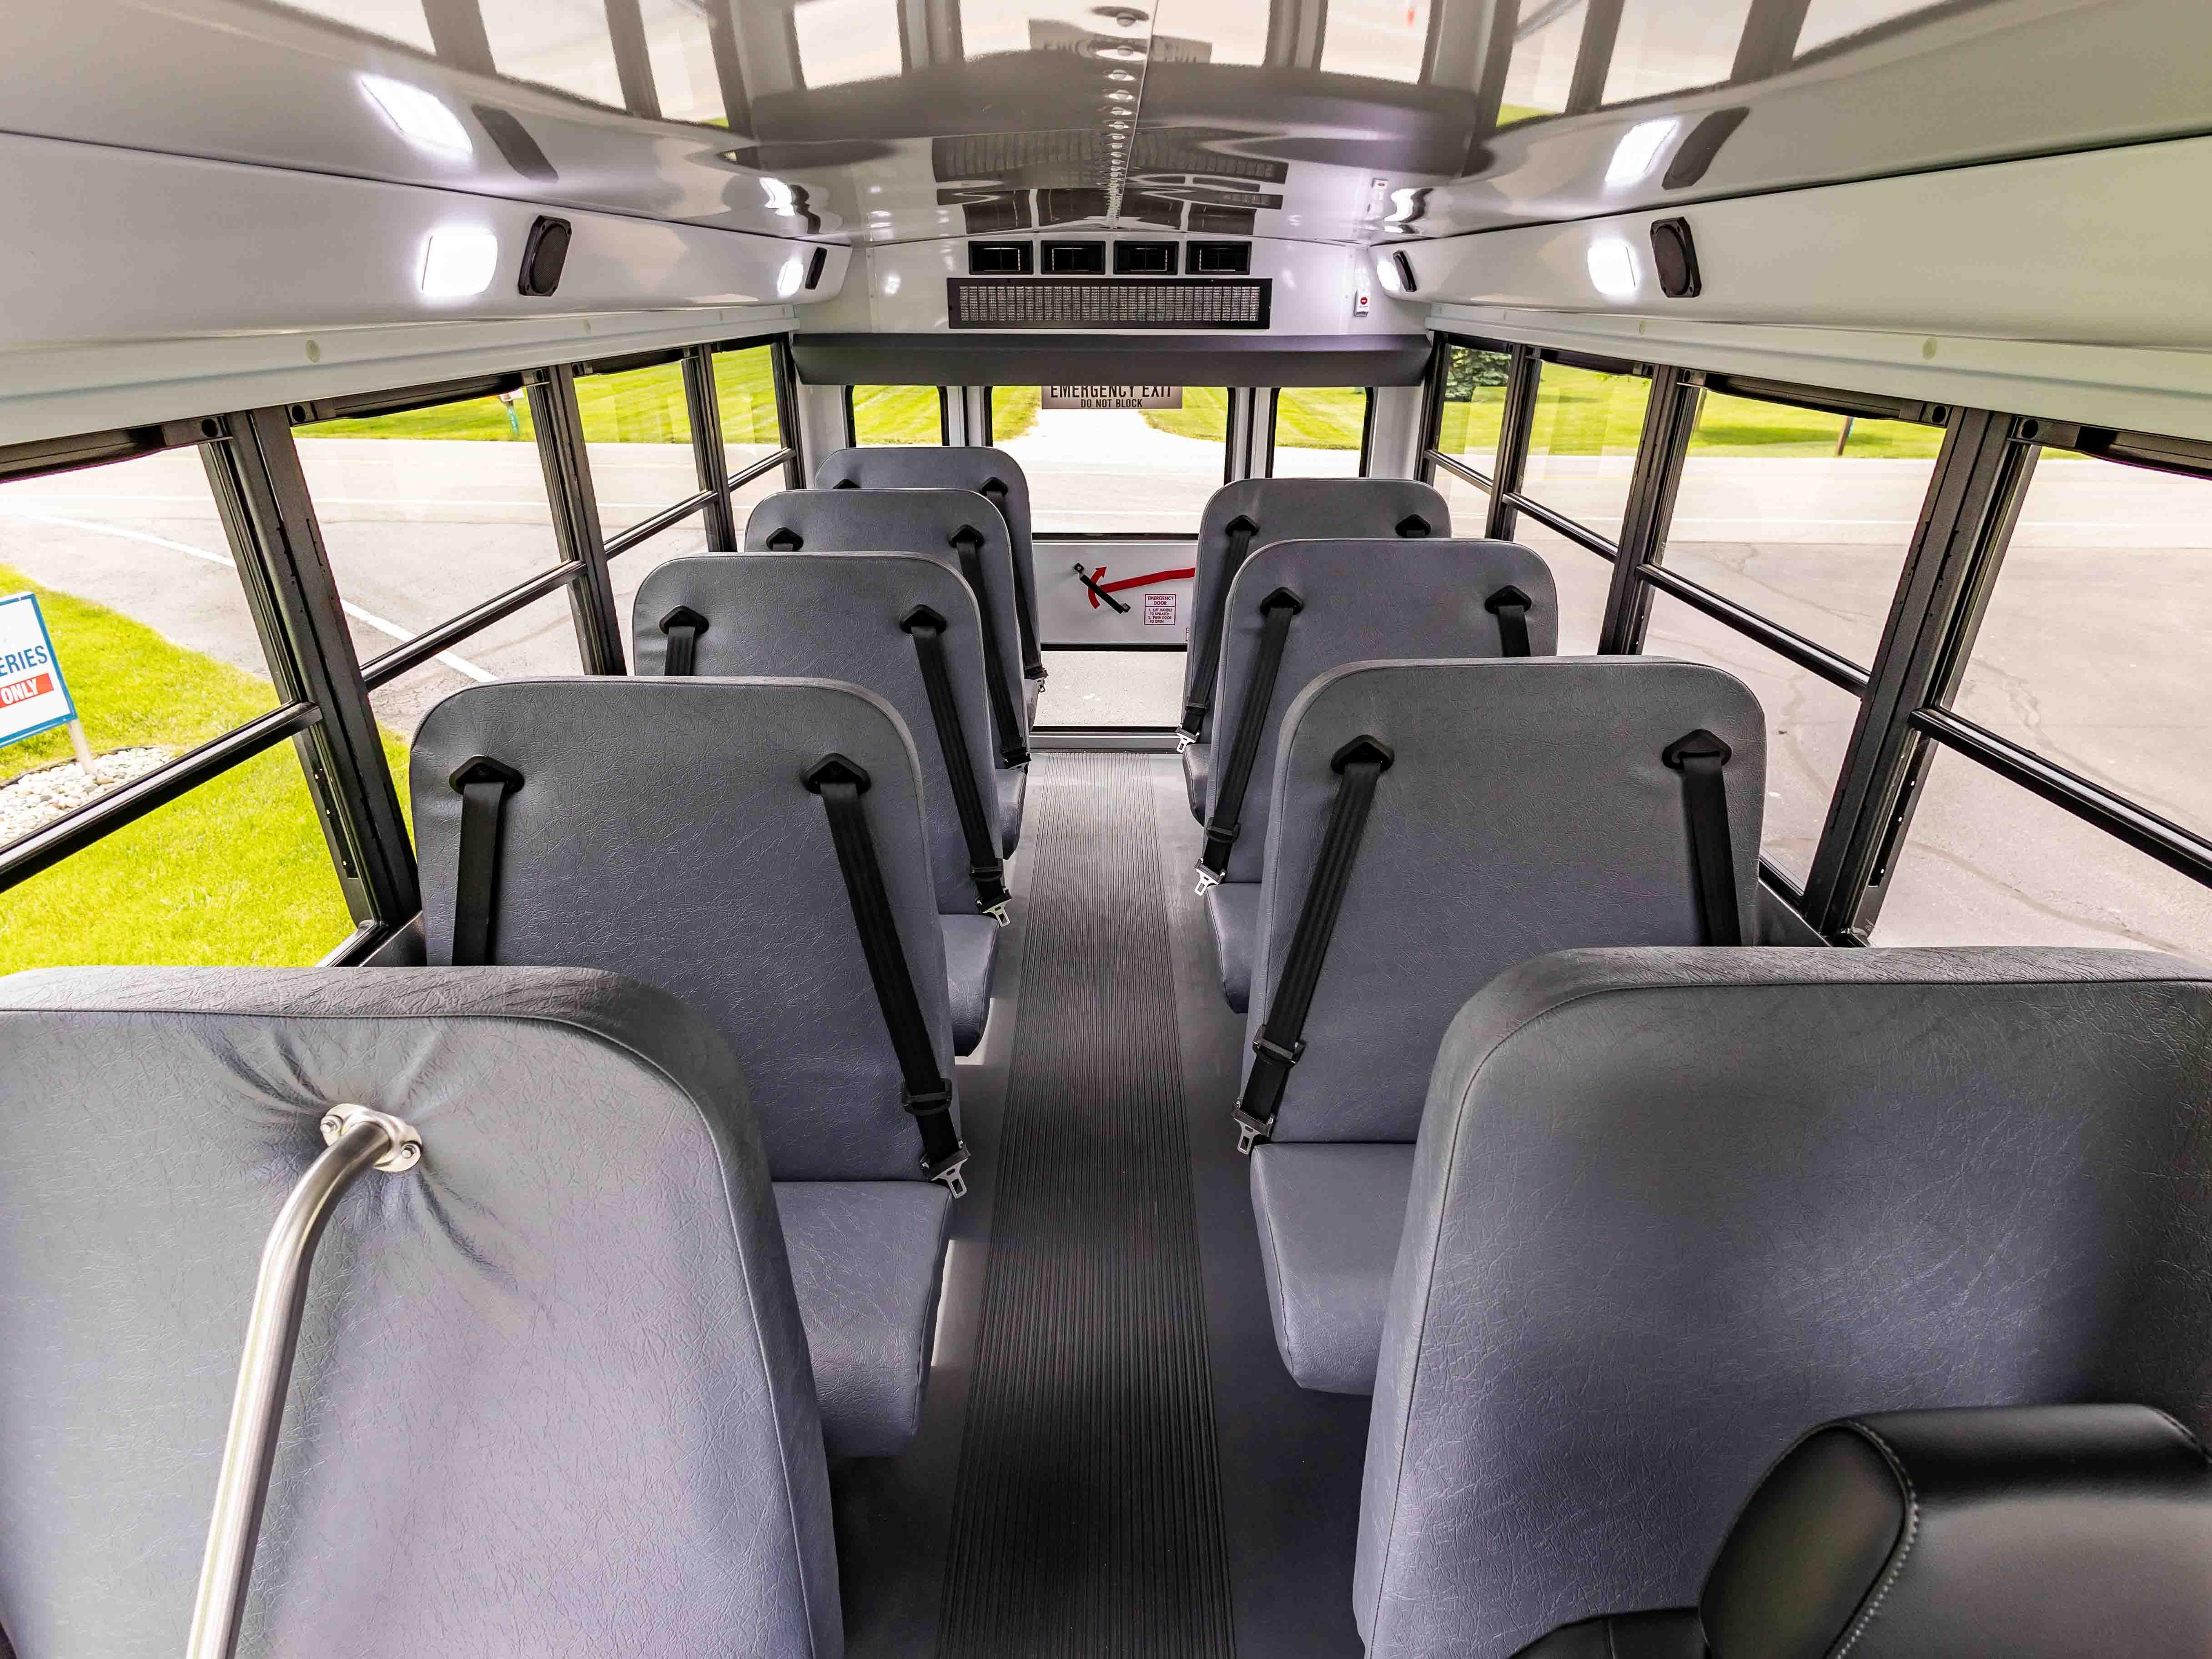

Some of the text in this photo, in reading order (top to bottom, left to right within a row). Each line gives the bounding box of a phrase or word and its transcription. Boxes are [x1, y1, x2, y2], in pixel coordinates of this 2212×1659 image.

[1051, 386, 1135, 397] EMERGENCY
[1081, 398, 1143, 408] DO NOT BLOCK
[0, 678, 39, 704] ONLY
